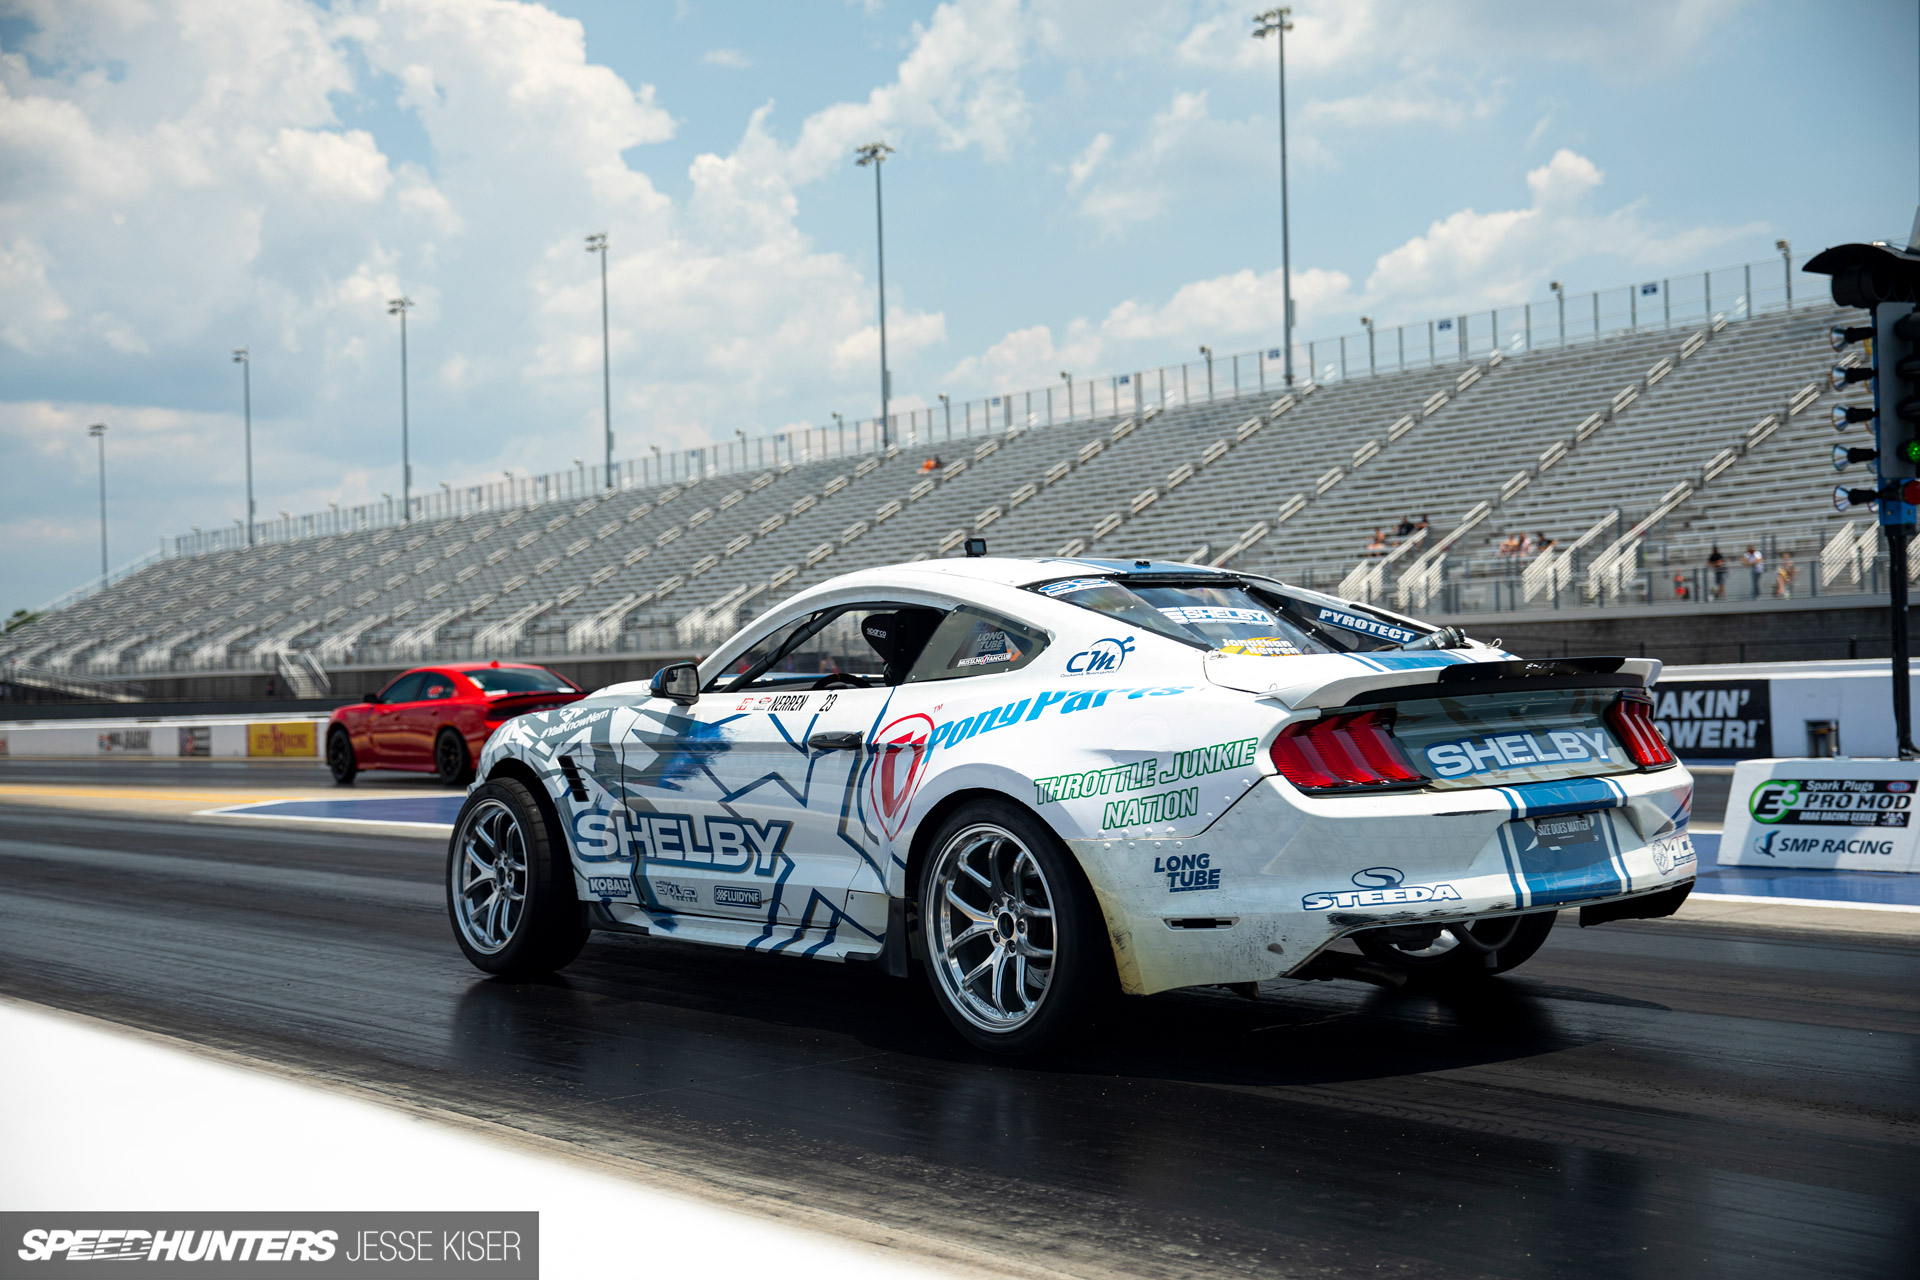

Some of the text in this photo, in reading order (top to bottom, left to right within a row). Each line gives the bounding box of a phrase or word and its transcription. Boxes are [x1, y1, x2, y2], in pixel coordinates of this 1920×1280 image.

[1319, 609, 1415, 642] PYROTECT
[977, 630, 1004, 642] LONG
[979, 639, 1004, 650] TUBE
[1222, 638, 1293, 648] Jonathan
[1246, 646, 1301, 655] Nerren
[767, 695, 809, 712] NERREN
[819, 694, 838, 712] 23
[1427, 732, 1608, 777] SHELBY
[1034, 737, 1258, 805] THROTTLE JUNKIE
[1806, 780, 1839, 792] Spark
[1842, 780, 1875, 793] Plugs
[1102, 787, 1198, 830] NATION
[1804, 794, 1912, 810] PRO MOD
[1537, 819, 1591, 836] SIZE DOES MATTER
[574, 813, 783, 870] SHELBY
[1778, 838, 1894, 855] SMP RACING
[1154, 853, 1210, 873] LONG
[590, 878, 631, 892] KOBALT
[1167, 869, 1221, 887] TUBE
[723, 890, 759, 902] FLUIDYNE
[1302, 884, 1462, 911] STEEDA
